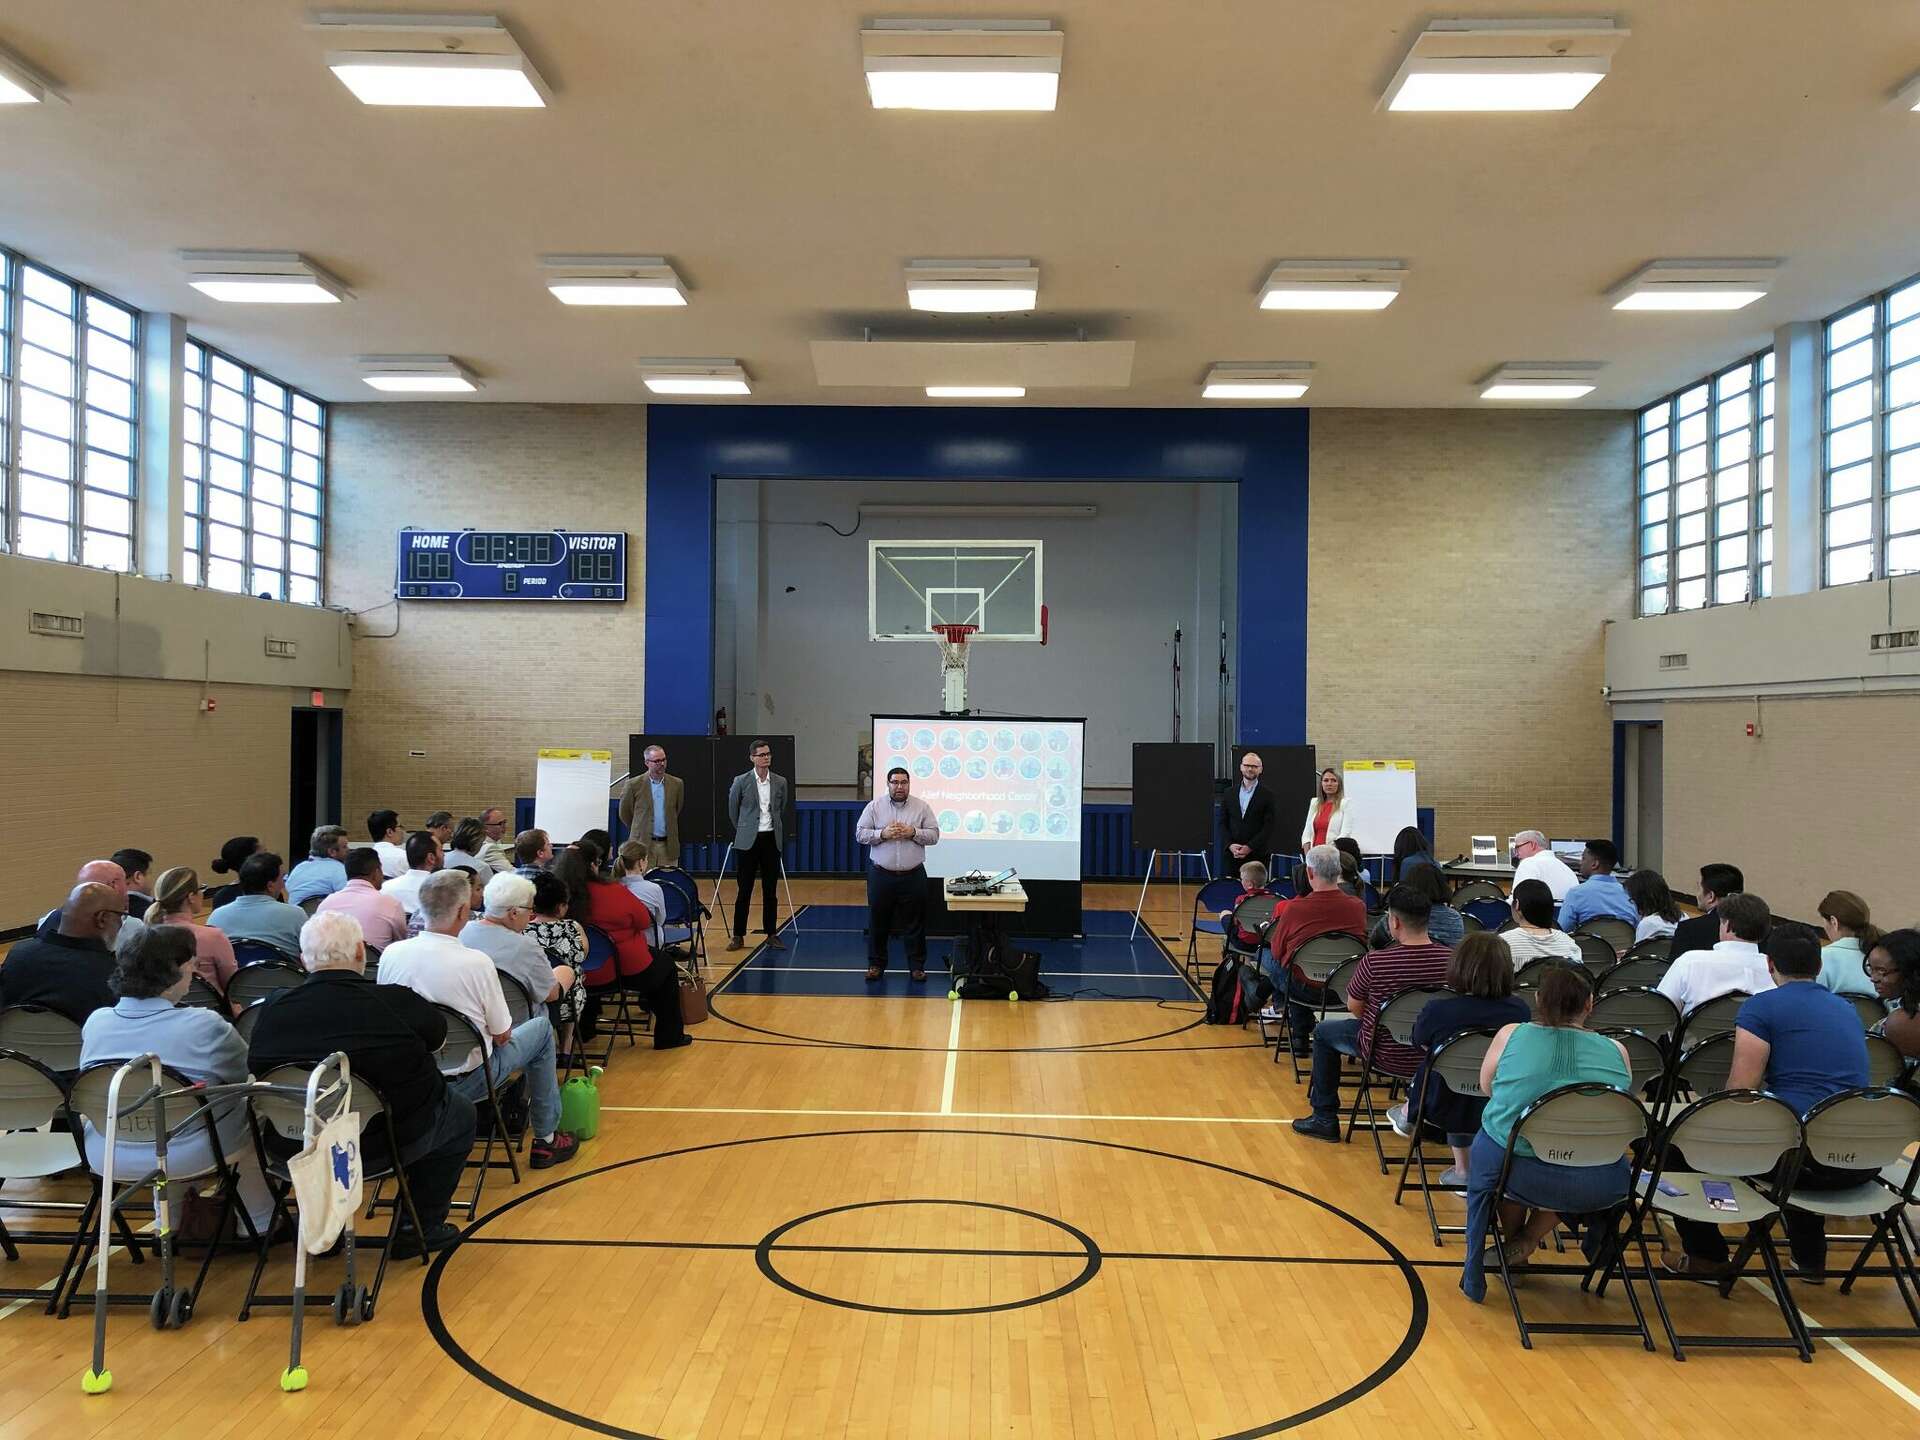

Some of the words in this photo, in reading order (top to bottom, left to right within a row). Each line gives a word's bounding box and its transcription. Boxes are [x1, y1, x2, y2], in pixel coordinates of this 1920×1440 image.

[412, 536, 449, 549] HOME
[569, 537, 616, 550] VISITOR
[523, 577, 547, 585] PERIOD
[1548, 1148, 1575, 1161] Alief
[1827, 1151, 1857, 1163] Alief
